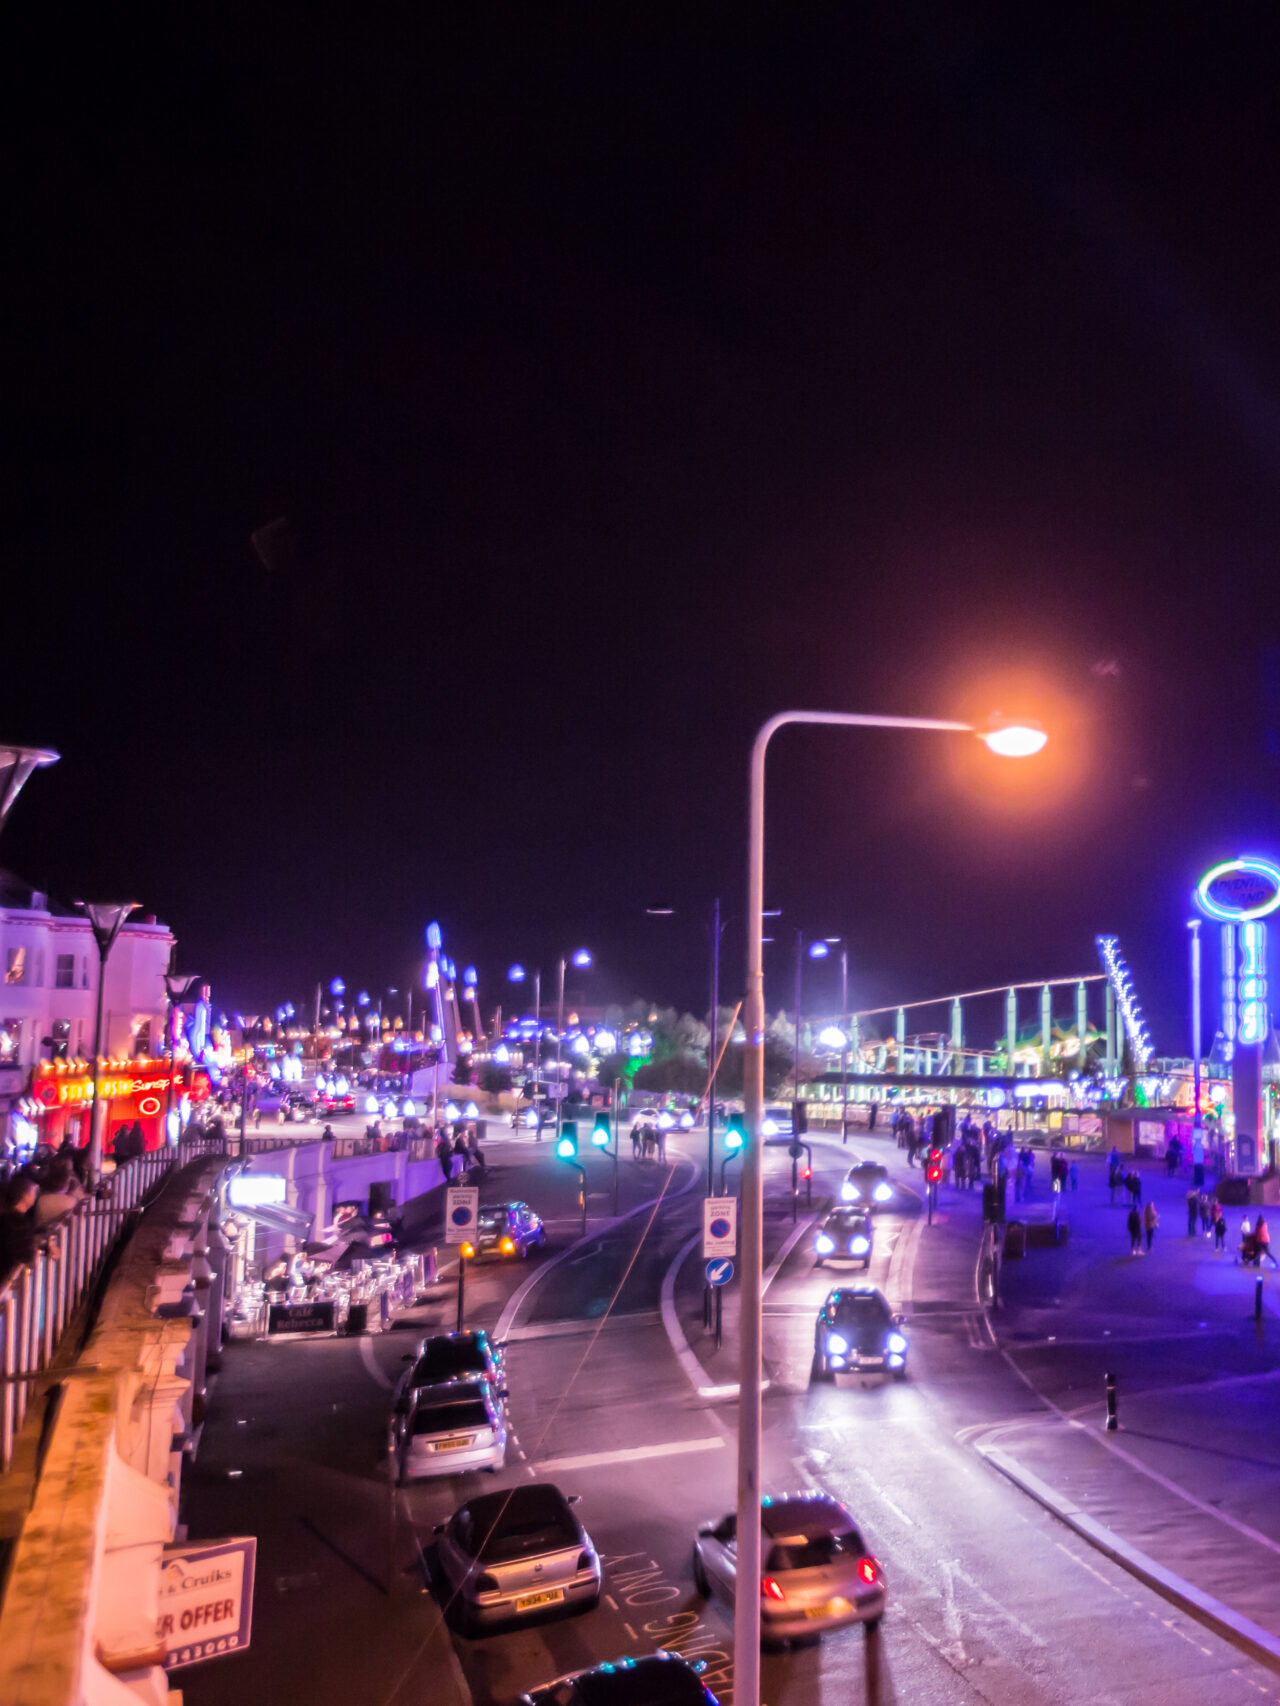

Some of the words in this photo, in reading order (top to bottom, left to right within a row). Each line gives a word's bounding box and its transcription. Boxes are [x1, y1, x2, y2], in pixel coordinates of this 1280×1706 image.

[131, 1074, 183, 1093] Sunspt
[601, 1552, 681, 1607] ONLY
[180, 1598, 235, 1631] OFFER
